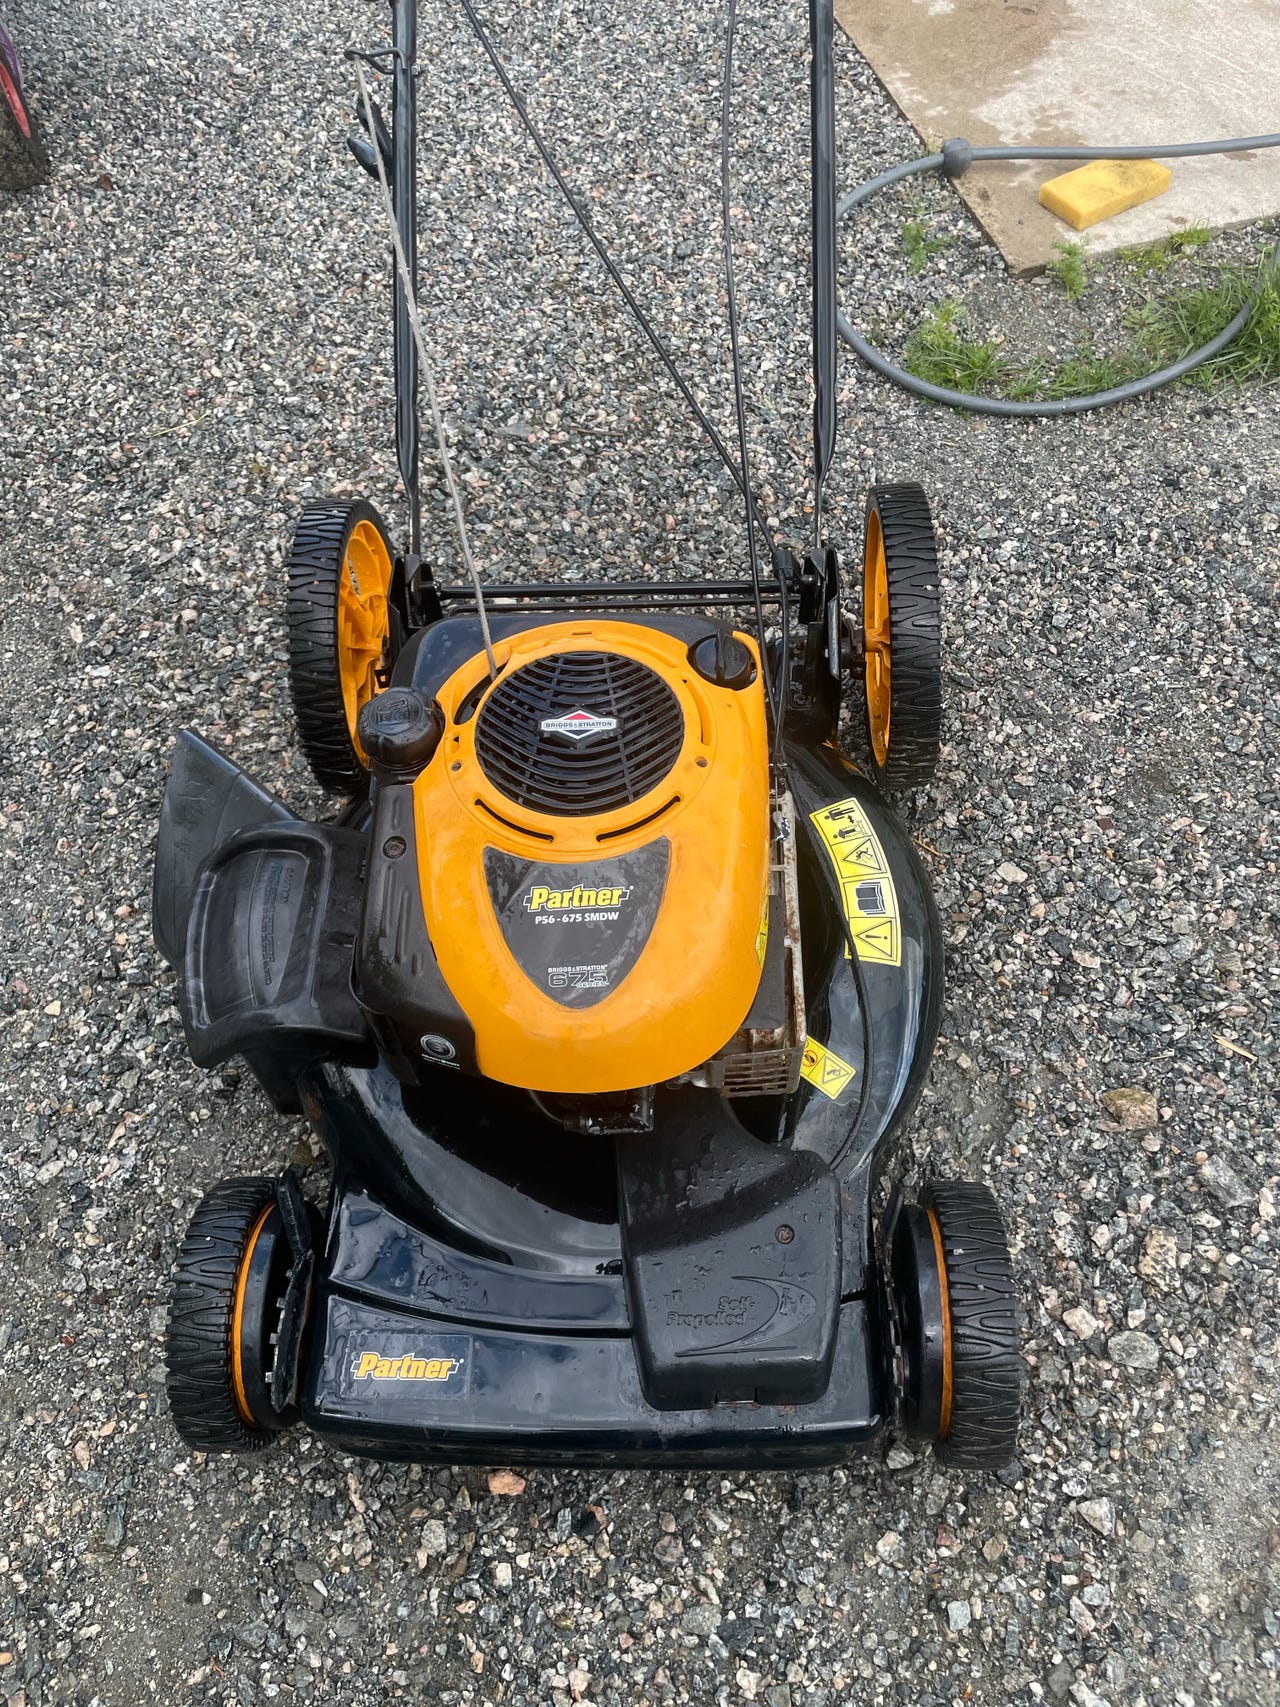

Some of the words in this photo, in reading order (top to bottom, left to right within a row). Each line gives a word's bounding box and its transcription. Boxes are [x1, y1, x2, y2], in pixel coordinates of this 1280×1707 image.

[527, 884, 625, 911] Partner
[584, 912, 619, 922] SMDW
[548, 970, 609, 988] 675
[354, 1352, 454, 1381] Partner
